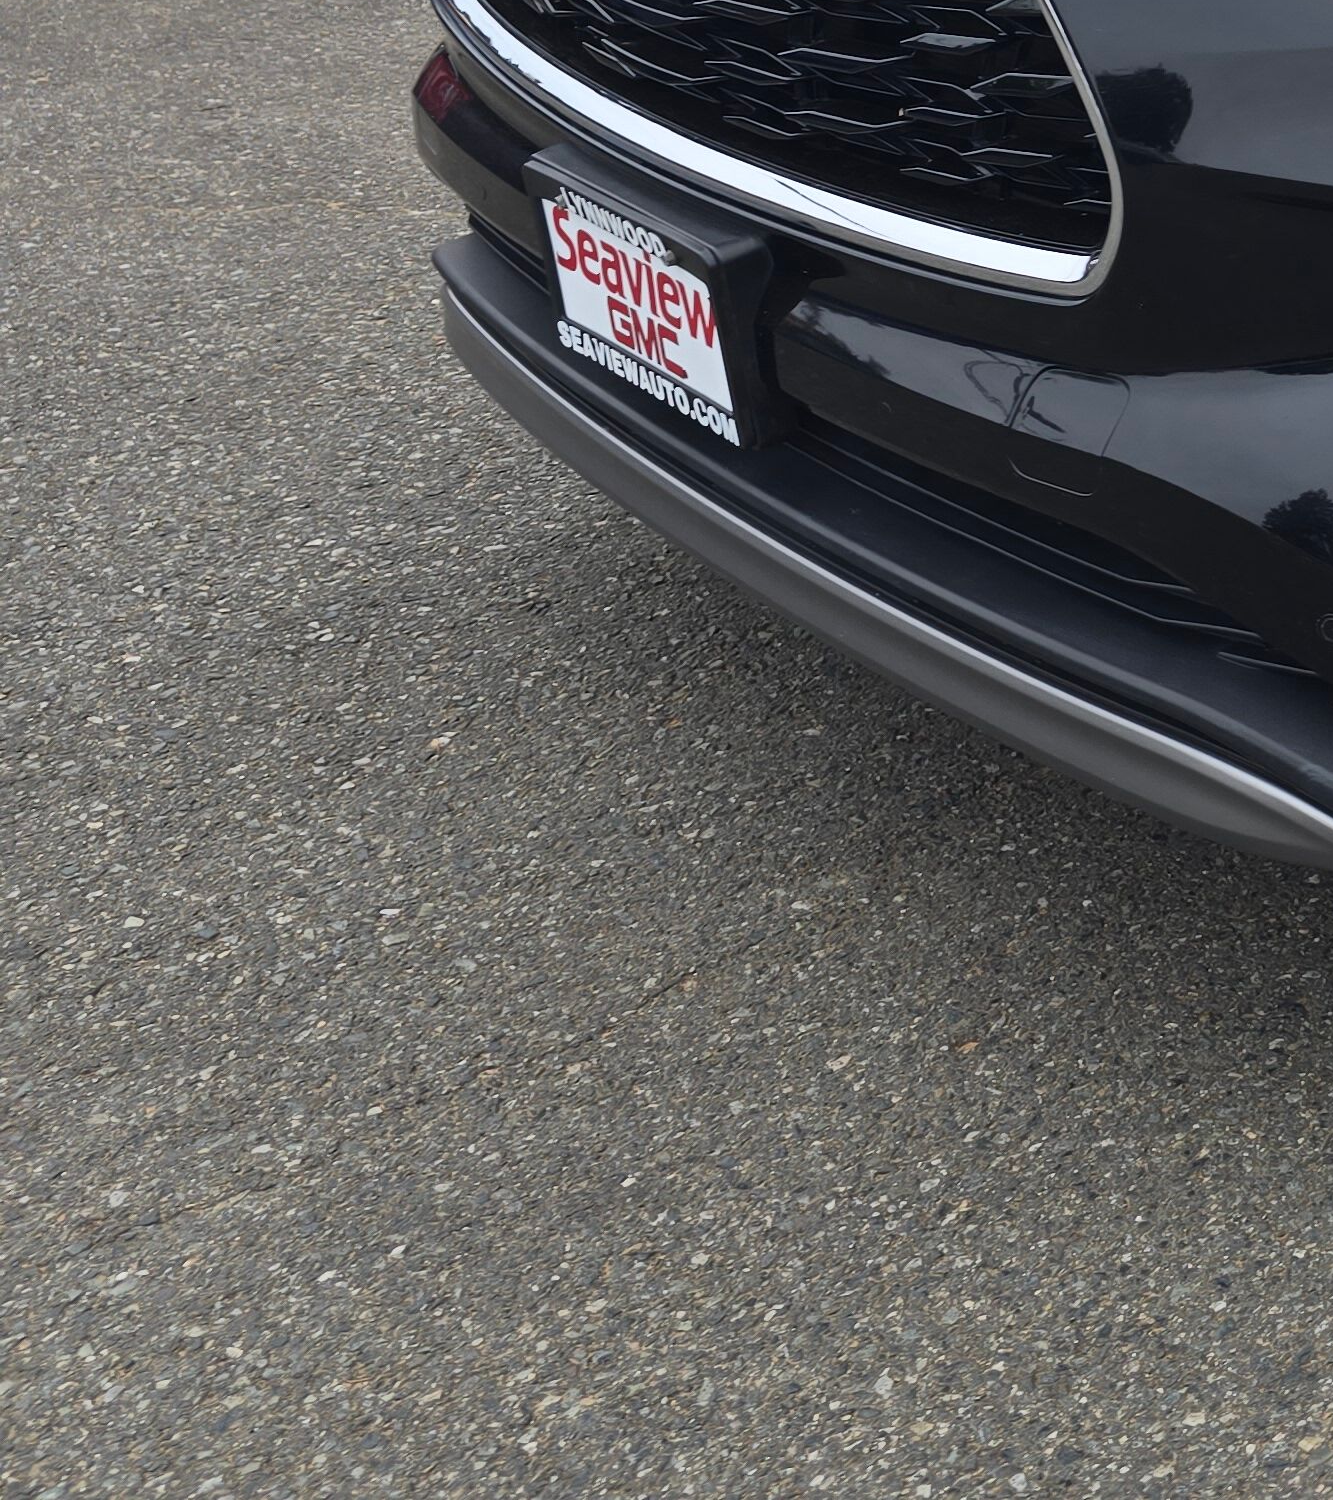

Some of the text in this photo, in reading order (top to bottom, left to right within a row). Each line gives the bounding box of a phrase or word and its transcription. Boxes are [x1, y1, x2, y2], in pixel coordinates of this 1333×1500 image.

[560, 186, 667, 258] LYNNWOOD
[552, 205, 717, 348] Seaview
[557, 320, 741, 447] SEAVIEWAUTO.COM
[608, 296, 688, 379] GMC
